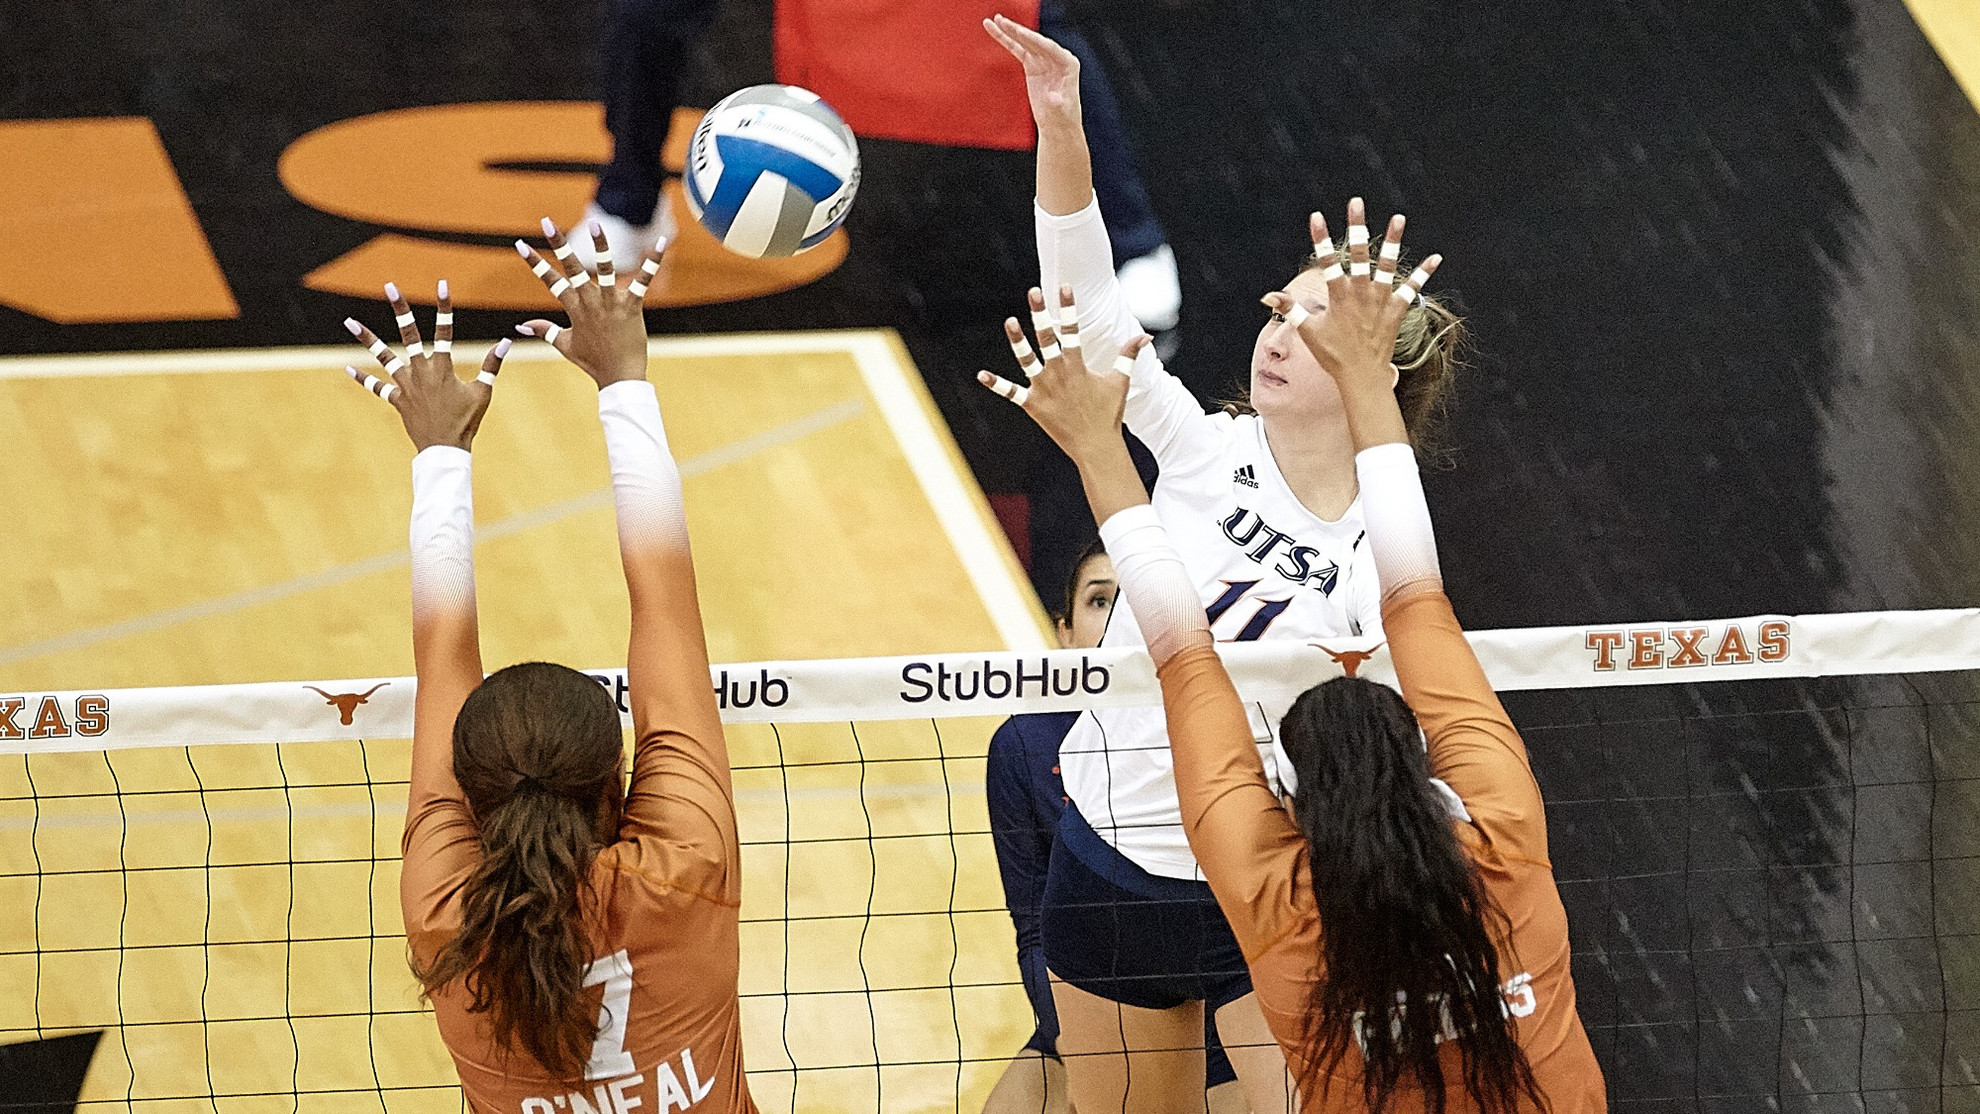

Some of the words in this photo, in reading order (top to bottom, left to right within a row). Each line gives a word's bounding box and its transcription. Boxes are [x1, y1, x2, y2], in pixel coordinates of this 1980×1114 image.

[1233, 474, 1259, 489] didas
[1222, 506, 1339, 598] UTSA
[1585, 620, 1793, 672] TEXAS
[899, 656, 1110, 704] StubHub
